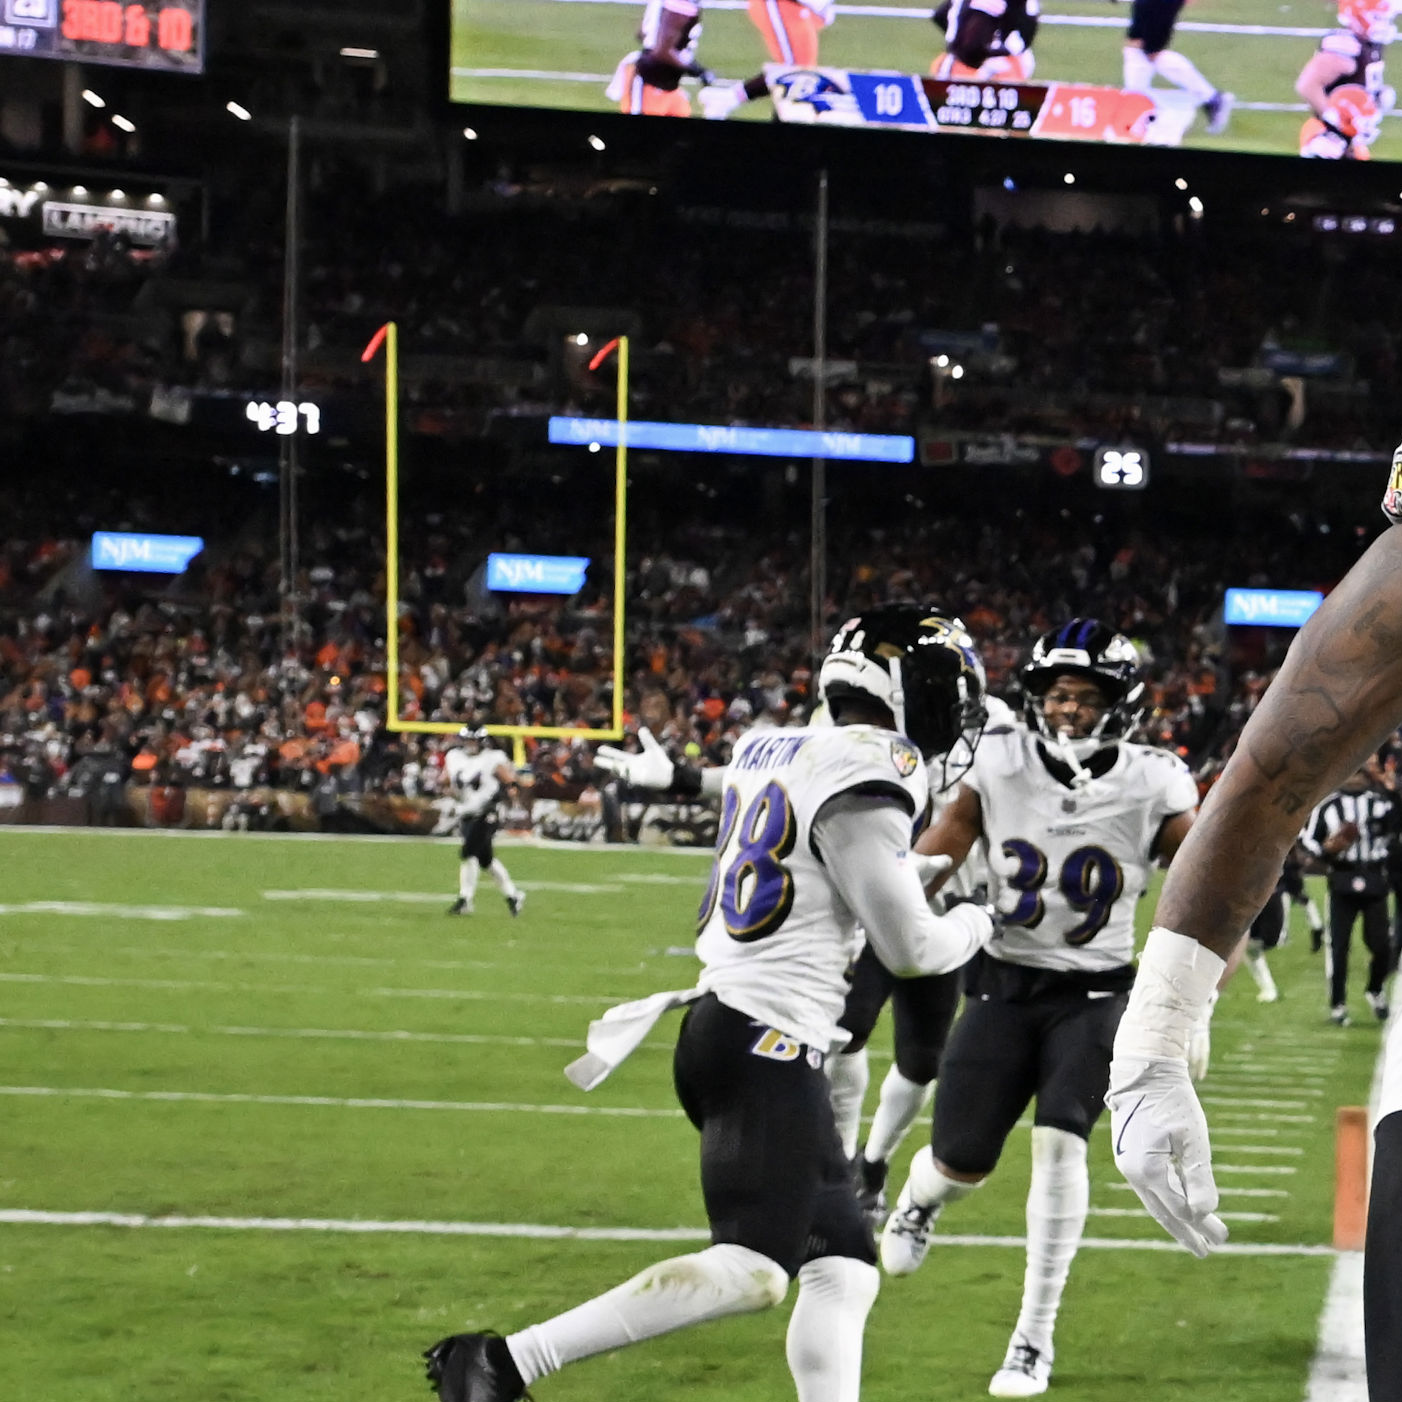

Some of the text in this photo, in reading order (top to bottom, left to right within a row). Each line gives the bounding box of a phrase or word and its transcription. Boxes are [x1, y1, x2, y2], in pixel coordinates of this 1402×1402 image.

[874, 84, 903, 116] 10
[1069, 96, 1097, 128] 16
[1101, 450, 1143, 485] 25
[101, 536, 150, 566] NJM
[496, 558, 544, 587] NJM
[1234, 593, 1279, 621] NJM
[735, 735, 809, 770] MARTIN
[1000, 837, 1124, 946] 39
